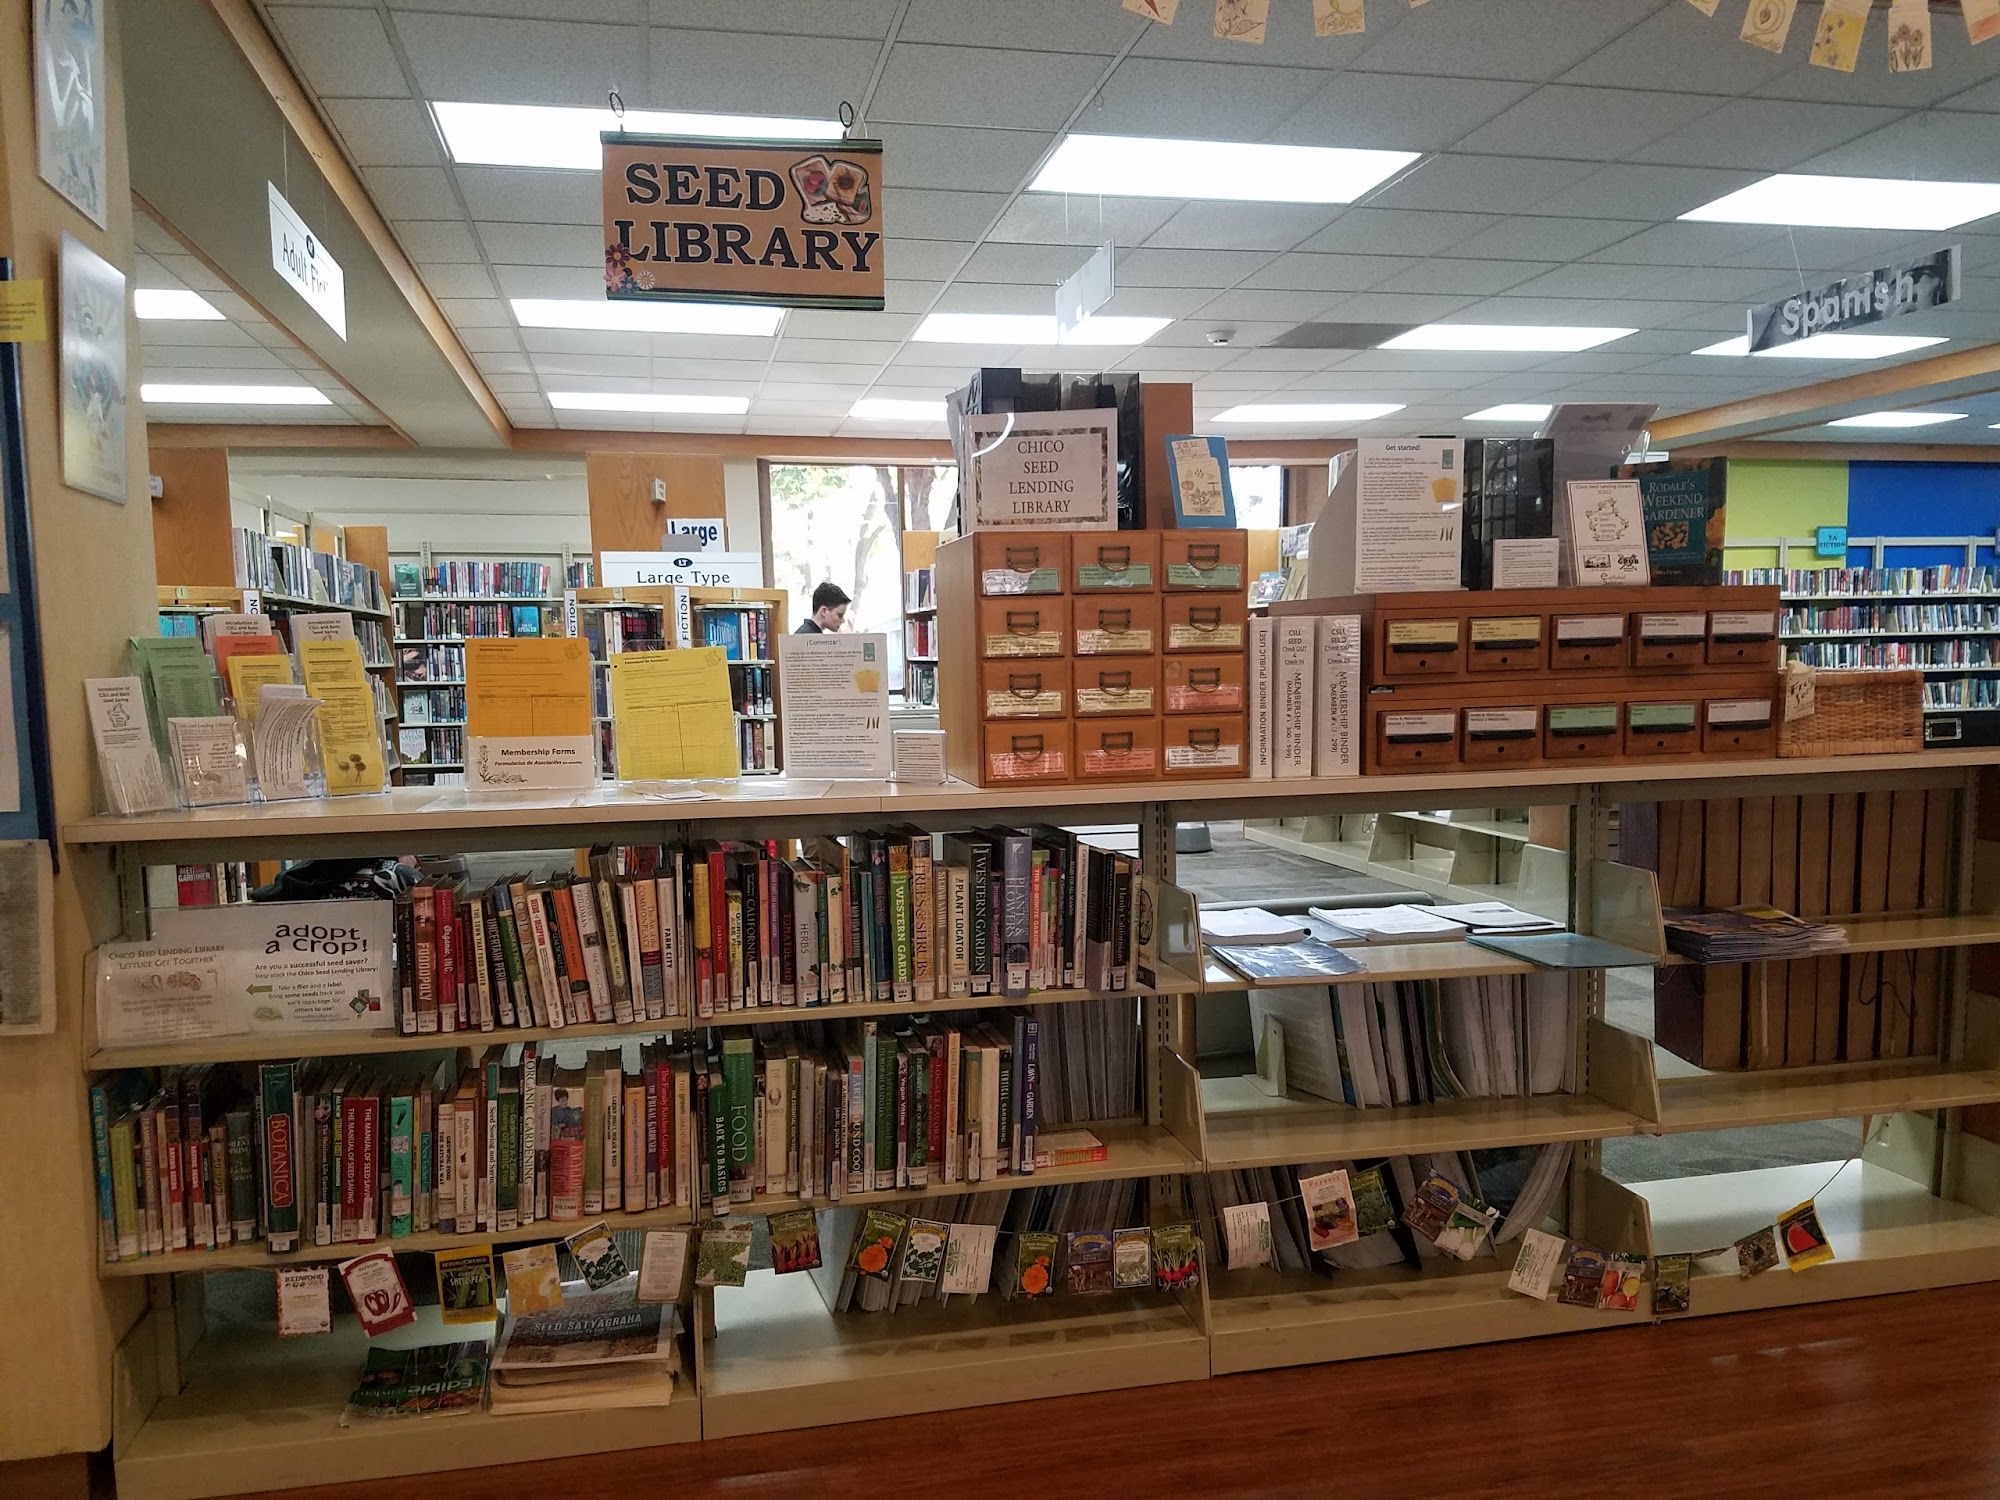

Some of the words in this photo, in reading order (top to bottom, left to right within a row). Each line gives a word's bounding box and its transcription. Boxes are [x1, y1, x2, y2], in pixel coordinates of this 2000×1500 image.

[626, 163, 786, 211] SEED
[614, 220, 880, 273] LIBRARY
[282, 232, 308, 287] Adult
[1780, 269, 1914, 337] Spanish
[1017, 439, 1064, 455] CHICO
[1023, 460, 1059, 474] SEED
[1008, 480, 1075, 496] LENDING
[1649, 480, 1696, 493] RODALE'S
[1012, 500, 1071, 514] LIBRARY
[1641, 493, 1703, 507] WEEKEND
[1643, 506, 1705, 521] GARDENER
[671, 520, 718, 547] Large
[678, 559, 688, 567] LT
[636, 570, 684, 585] Large
[690, 570, 731, 587] Type
[680, 594, 689, 641] FICTION
[1259, 630, 1268, 648] USE)
[1259, 650, 1268, 679] (PUBLIC
[1259, 681, 1268, 709] BINDER
[1285, 680, 1293, 713] (MEMBER
[1293, 672, 1302, 730] MEMBERSHIP
[1329, 683, 1338, 716] (MEMBER
[1338, 671, 1348, 730] MEMBERSHIP
[1259, 711, 1268, 766] INFORMATION
[1293, 733, 1302, 766] BINDER
[1330, 738, 1338, 753] 299)
[1340, 731, 1349, 765] BINDER
[552, 748, 576, 756] Forms
[1284, 744, 1292, 759] 599)
[915, 860, 927, 908] TREES
[975, 856, 987, 917] WESTERN
[530, 898, 540, 914] SEEDS
[955, 884, 964, 915] PLANT
[1005, 877, 1016, 938] FLOWERS
[1015, 877, 1026, 925] PLANTS
[1117, 887, 1127, 912] Hardy
[638, 885, 650, 950] COMMONPLACE
[895, 885, 906, 942] WESTERN
[275, 924, 361, 941] adopt
[486, 917, 503, 961] UNCERTAIN
[534, 919, 546, 946] DECEPTION
[664, 928, 672, 950] FARM
[746, 898, 756, 961] CALIFORNIA
[800, 923, 809, 955] HERBS
[955, 917, 964, 960] LOCATOR
[1117, 914, 1127, 962] Californians
[108, 951, 136, 960] CHICO
[137, 950, 156, 959] SEED
[158, 947, 193, 956] LENDING
[195, 945, 225, 954] LIBRARY
[265, 940, 281, 954] a
[292, 938, 368, 955] crop!
[783, 912, 792, 981] TOMATOLAND
[915, 921, 928, 977] SHRUBS
[974, 919, 986, 973] GARDEN
[154, 959, 170, 967] GET
[268, 964, 282, 972] you
[289, 960, 326, 969] successful
[327, 959, 344, 967] seed
[345, 957, 368, 966] saver?
[331, 967, 355, 976] Lending
[355, 966, 379, 974] Library!
[477, 952, 485, 968] FOOD
[665, 951, 673, 969] CITY
[479, 969, 487, 986] SAVED
[268, 993, 284, 1001] Bring
[660, 1069, 669, 1082] The
[1026, 1063, 1035, 1082] LAWN
[524, 1060, 535, 1115] ORGANIC
[659, 1082, 669, 1106] Family
[899, 1077, 907, 1101] Vegan
[1000, 1070, 1010, 1101] VERTICAL
[347, 1107, 355, 1121] THE
[364, 1107, 372, 1121] THE
[646, 1095, 657, 1120] FRUGAL
[678, 1093, 686, 1115] green
[852, 1073, 862, 1147] EARTHBOUND
[1026, 1091, 1035, 1119] GARDEN
[538, 1108, 546, 1131] Organic
[661, 1106, 669, 1133] Kitchen
[714, 1116, 726, 1142] BACK
[346, 1121, 355, 1152] MANUAL
[363, 1122, 372, 1152] MANUAL
[488, 1123, 496, 1150] Sowing
[647, 1120, 657, 1153] GARDENER
[730, 1104, 747, 1162] FOOD
[271, 1119, 289, 1202] BOTANICA
[321, 1136, 329, 1164] Heirloom
[346, 1152, 355, 1161] OF
[363, 1152, 372, 1161] OF
[488, 1150, 496, 1163] and
[523, 1116, 535, 1186] GARDENING
[715, 1143, 726, 1156] TO
[321, 1164, 329, 1175] Life
[346, 1161, 355, 1179] SEED
[363, 1161, 371, 1179] SEED
[716, 1157, 727, 1193] BASICS
[346, 1179, 355, 1204] SAVING
[284, 1273, 325, 1283] REDWOOD
[357, 1261, 380, 1272] PEPPERS
[533, 1322, 562, 1331] SEED
[568, 1313, 642, 1331] SATYAGRAHA
[408, 1378, 473, 1395] Edible
